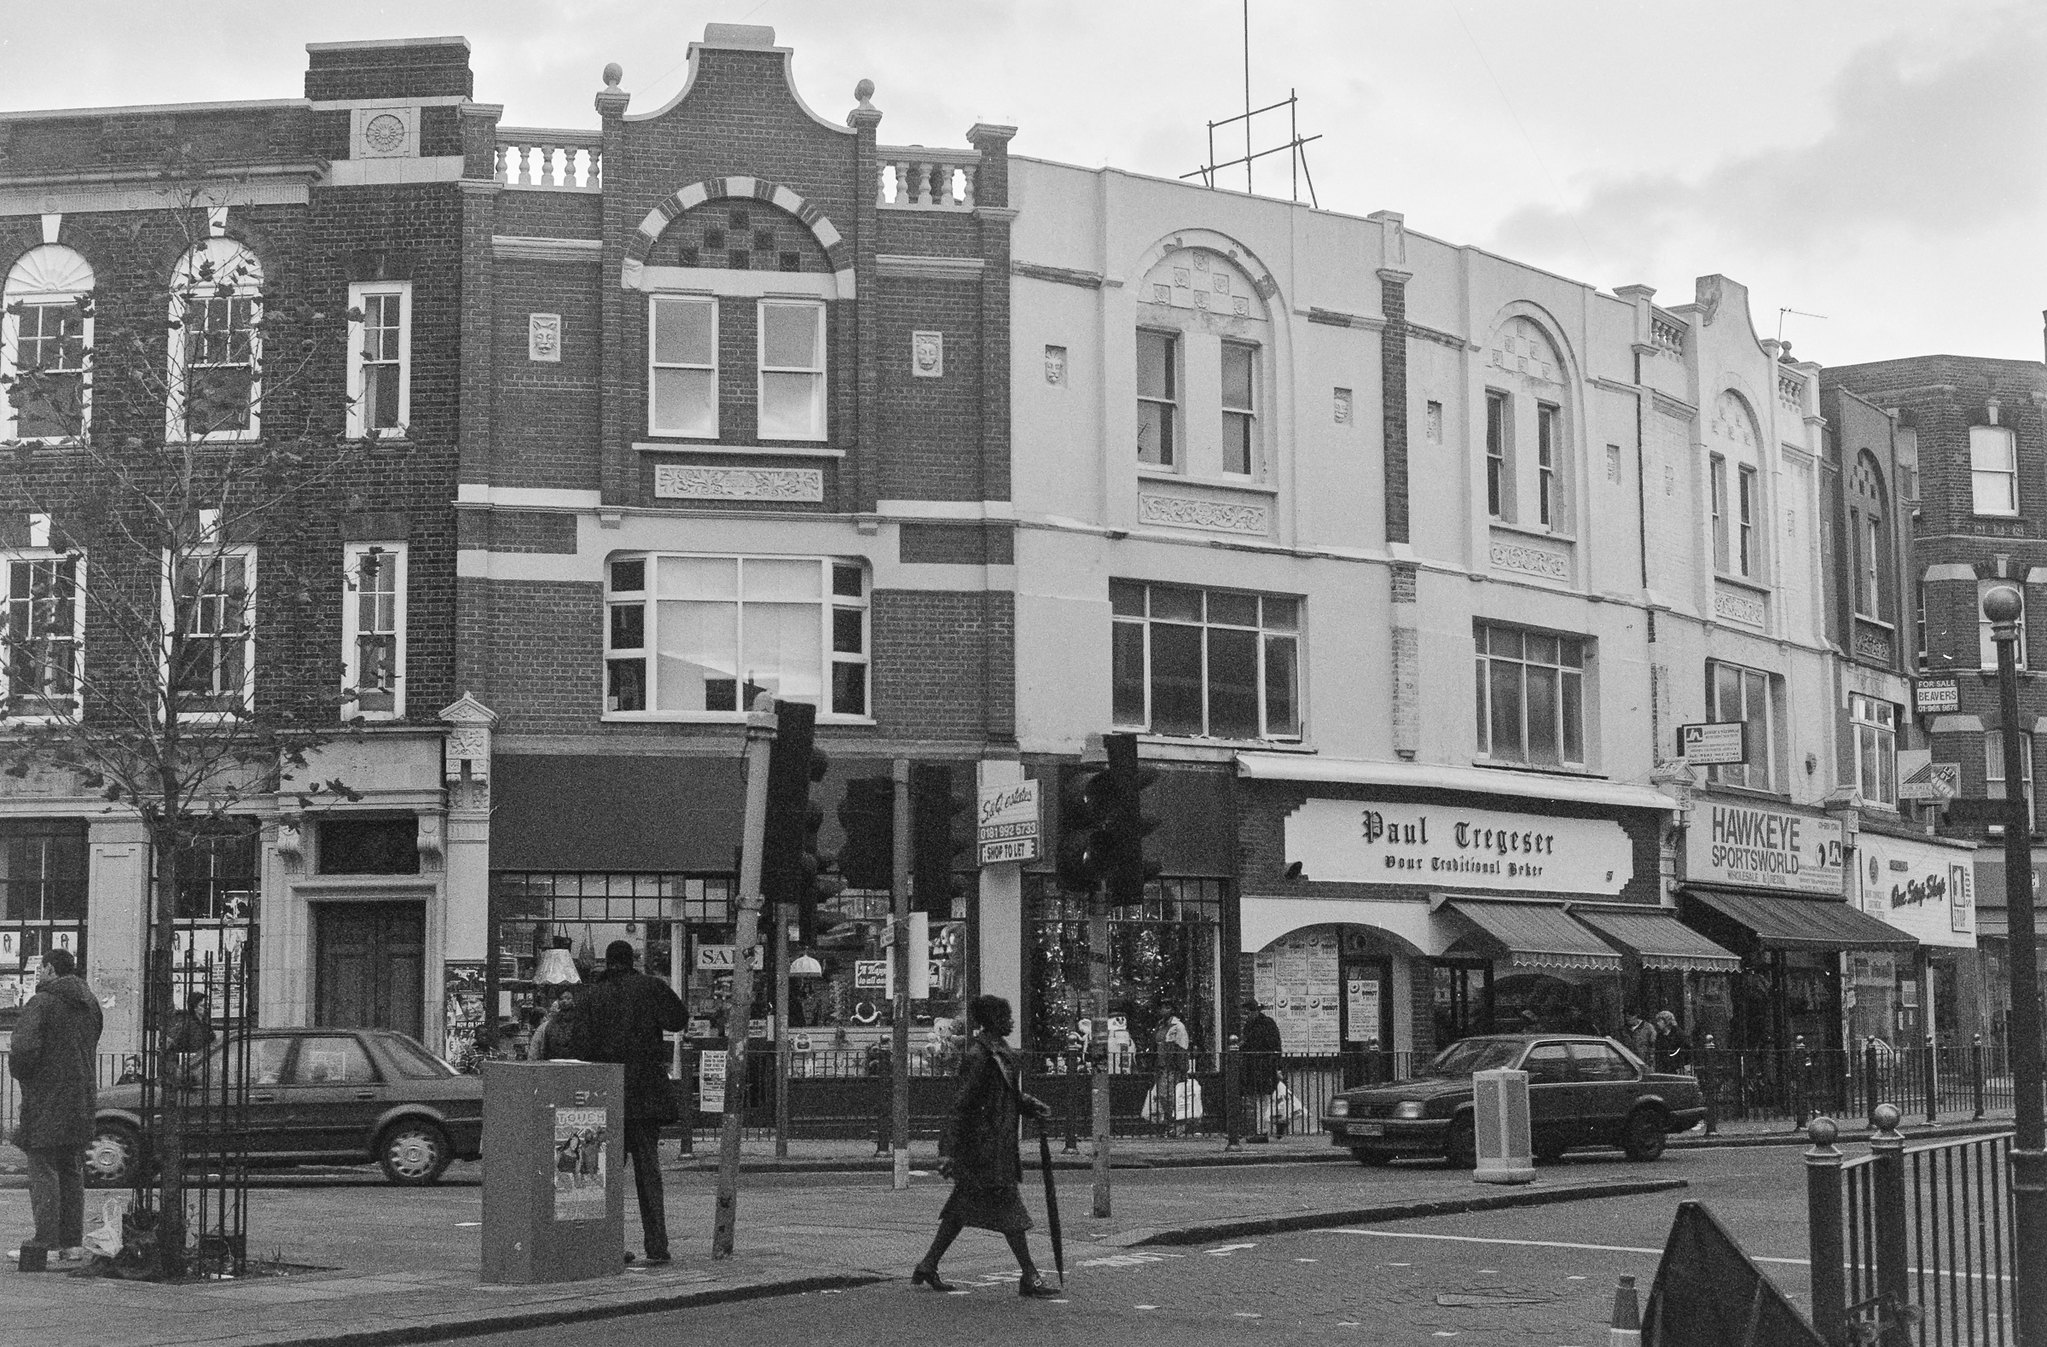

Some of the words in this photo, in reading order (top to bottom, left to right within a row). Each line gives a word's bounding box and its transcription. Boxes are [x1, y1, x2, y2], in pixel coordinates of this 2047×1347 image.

[1919, 691, 1956, 701] BEAVERS
[980, 827, 998, 840] 0181
[999, 824, 1014, 837] 992
[1362, 810, 1429, 844] Paul
[1454, 821, 1554, 856] Tregeser
[1712, 806, 1801, 852] HAWKEYE
[987, 844, 1003, 860] SHOP
[1004, 843, 1013, 858] TO
[1014, 842, 1025, 857] LET
[1712, 845, 1799, 875] SPORTSWORLD
[1384, 855, 1423, 870] Your
[1430, 855, 1500, 874] Traditional
[1727, 870, 1758, 882] WHOLESALE
[1891, 884, 1907, 909] One
[1907, 879, 1926, 907] Stop
[1926, 874, 1947, 901] Shop
[1964, 866, 1972, 908] SHOP
[702, 950, 759, 967] SA
[556, 1111, 607, 1125] TOUCH
